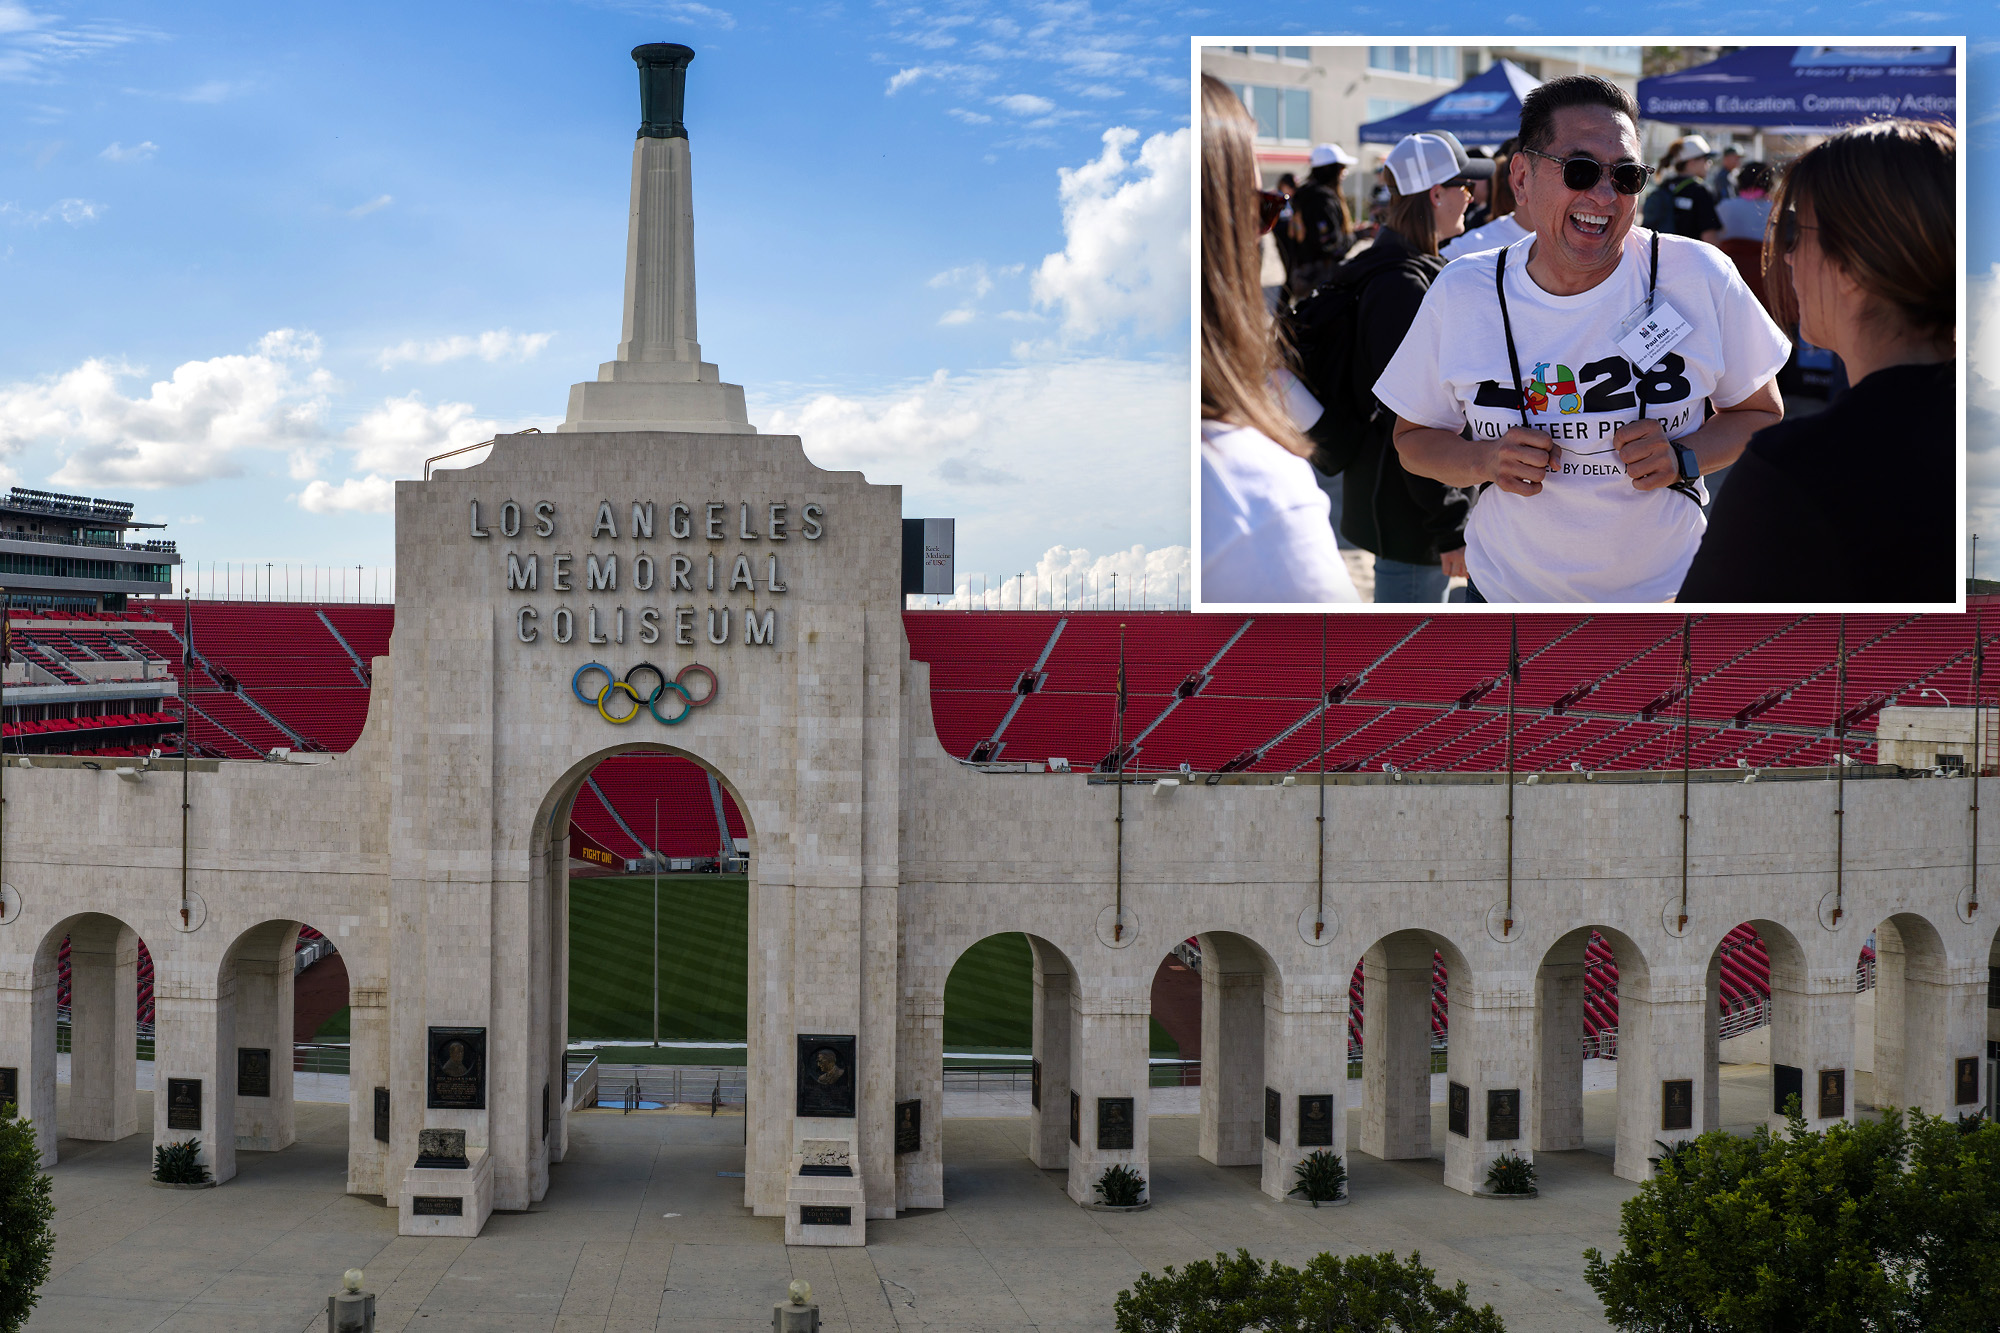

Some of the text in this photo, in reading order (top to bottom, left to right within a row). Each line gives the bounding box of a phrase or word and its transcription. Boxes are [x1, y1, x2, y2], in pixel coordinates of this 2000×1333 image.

[1715, 95, 1799, 113] Education.
[1803, 93, 1899, 115] Community
[1645, 337, 1659, 350] Paul
[1656, 327, 1670, 340] Ruiz
[1475, 407, 1690, 439] VOLTEER PRRAM
[1563, 463, 1579, 474] BY
[1583, 464, 1621, 475] DELTA
[470, 500, 823, 540] LOS ANGELES
[507, 552, 787, 592] MEMORIAL
[516, 606, 775, 646] COLISEUM
[582, 847, 612, 864] FIGHT ON!
